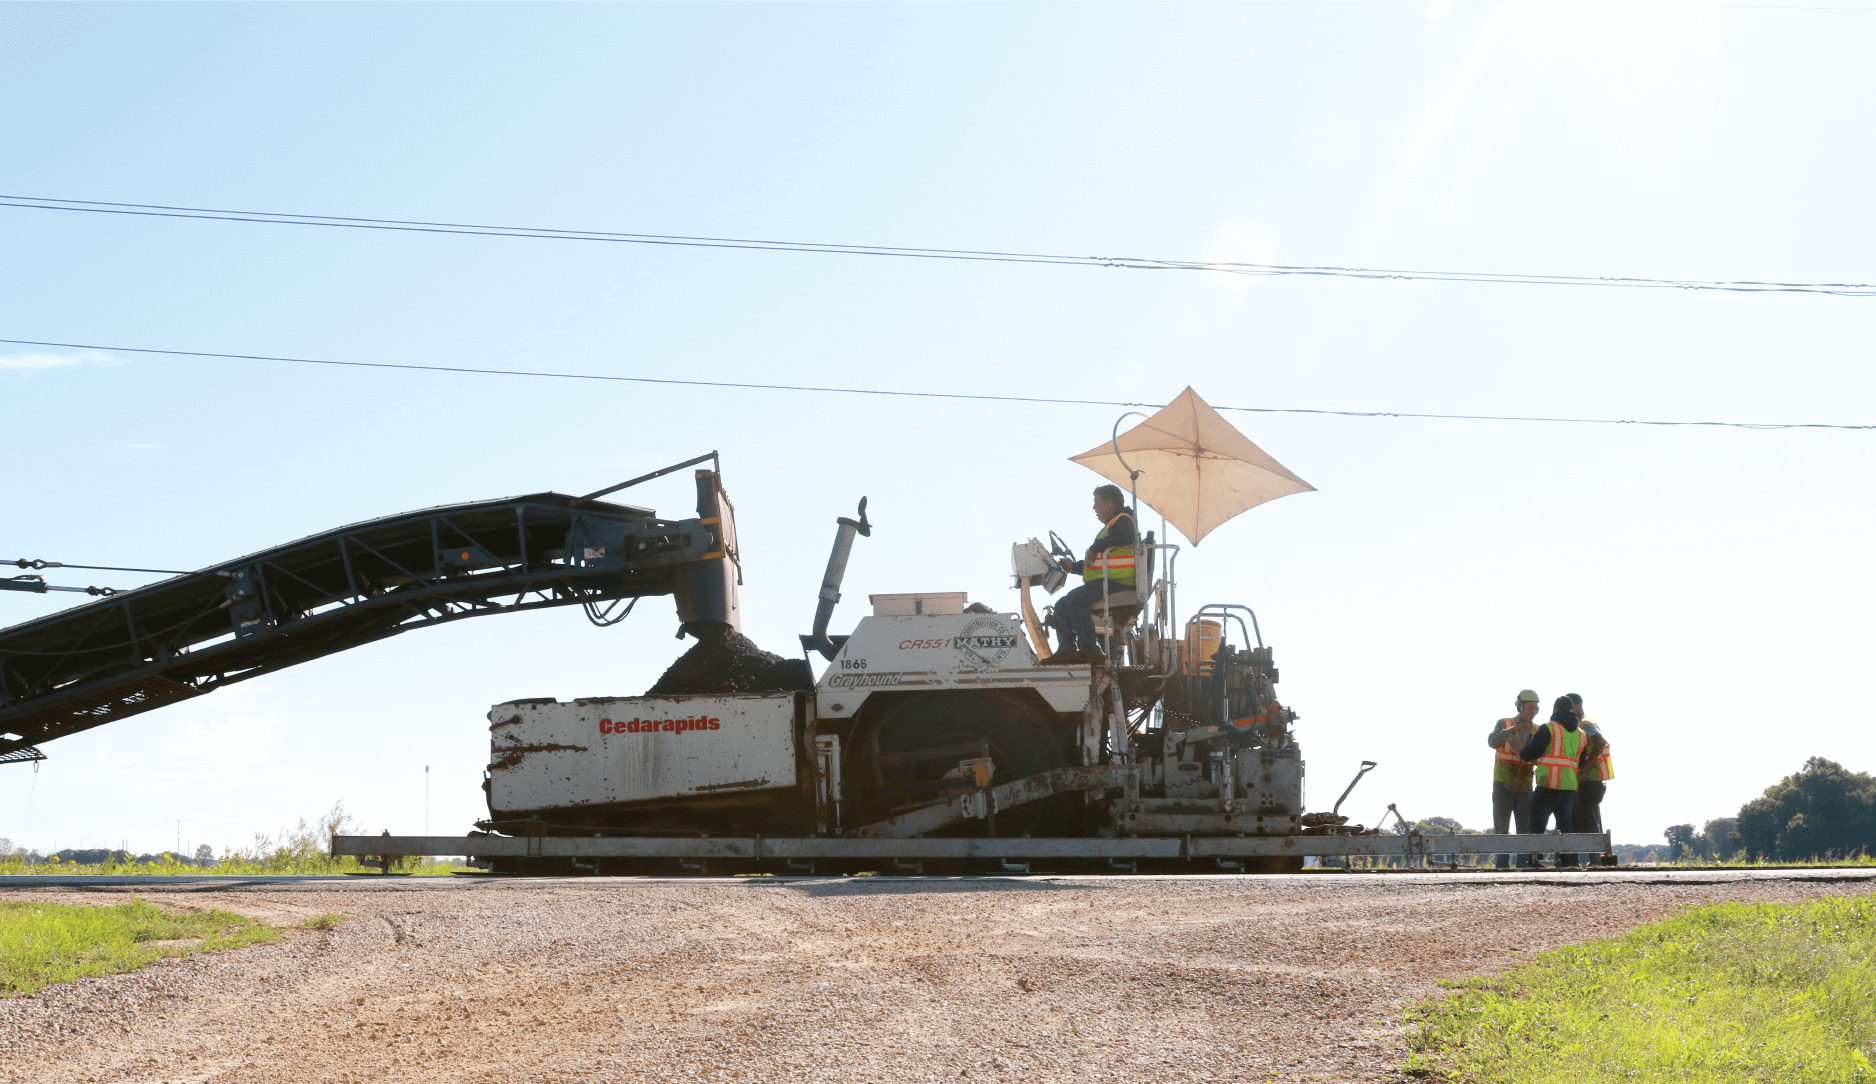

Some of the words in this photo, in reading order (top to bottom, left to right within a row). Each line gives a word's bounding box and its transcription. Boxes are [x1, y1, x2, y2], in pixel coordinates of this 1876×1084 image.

[963, 620, 999, 636] CONSTRUCTION
[898, 638, 952, 650] CR551
[955, 636, 1015, 648] MATHY
[840, 659, 867, 670] 1866
[829, 671, 903, 691] Grayhound
[599, 715, 721, 735] Cedarapids
